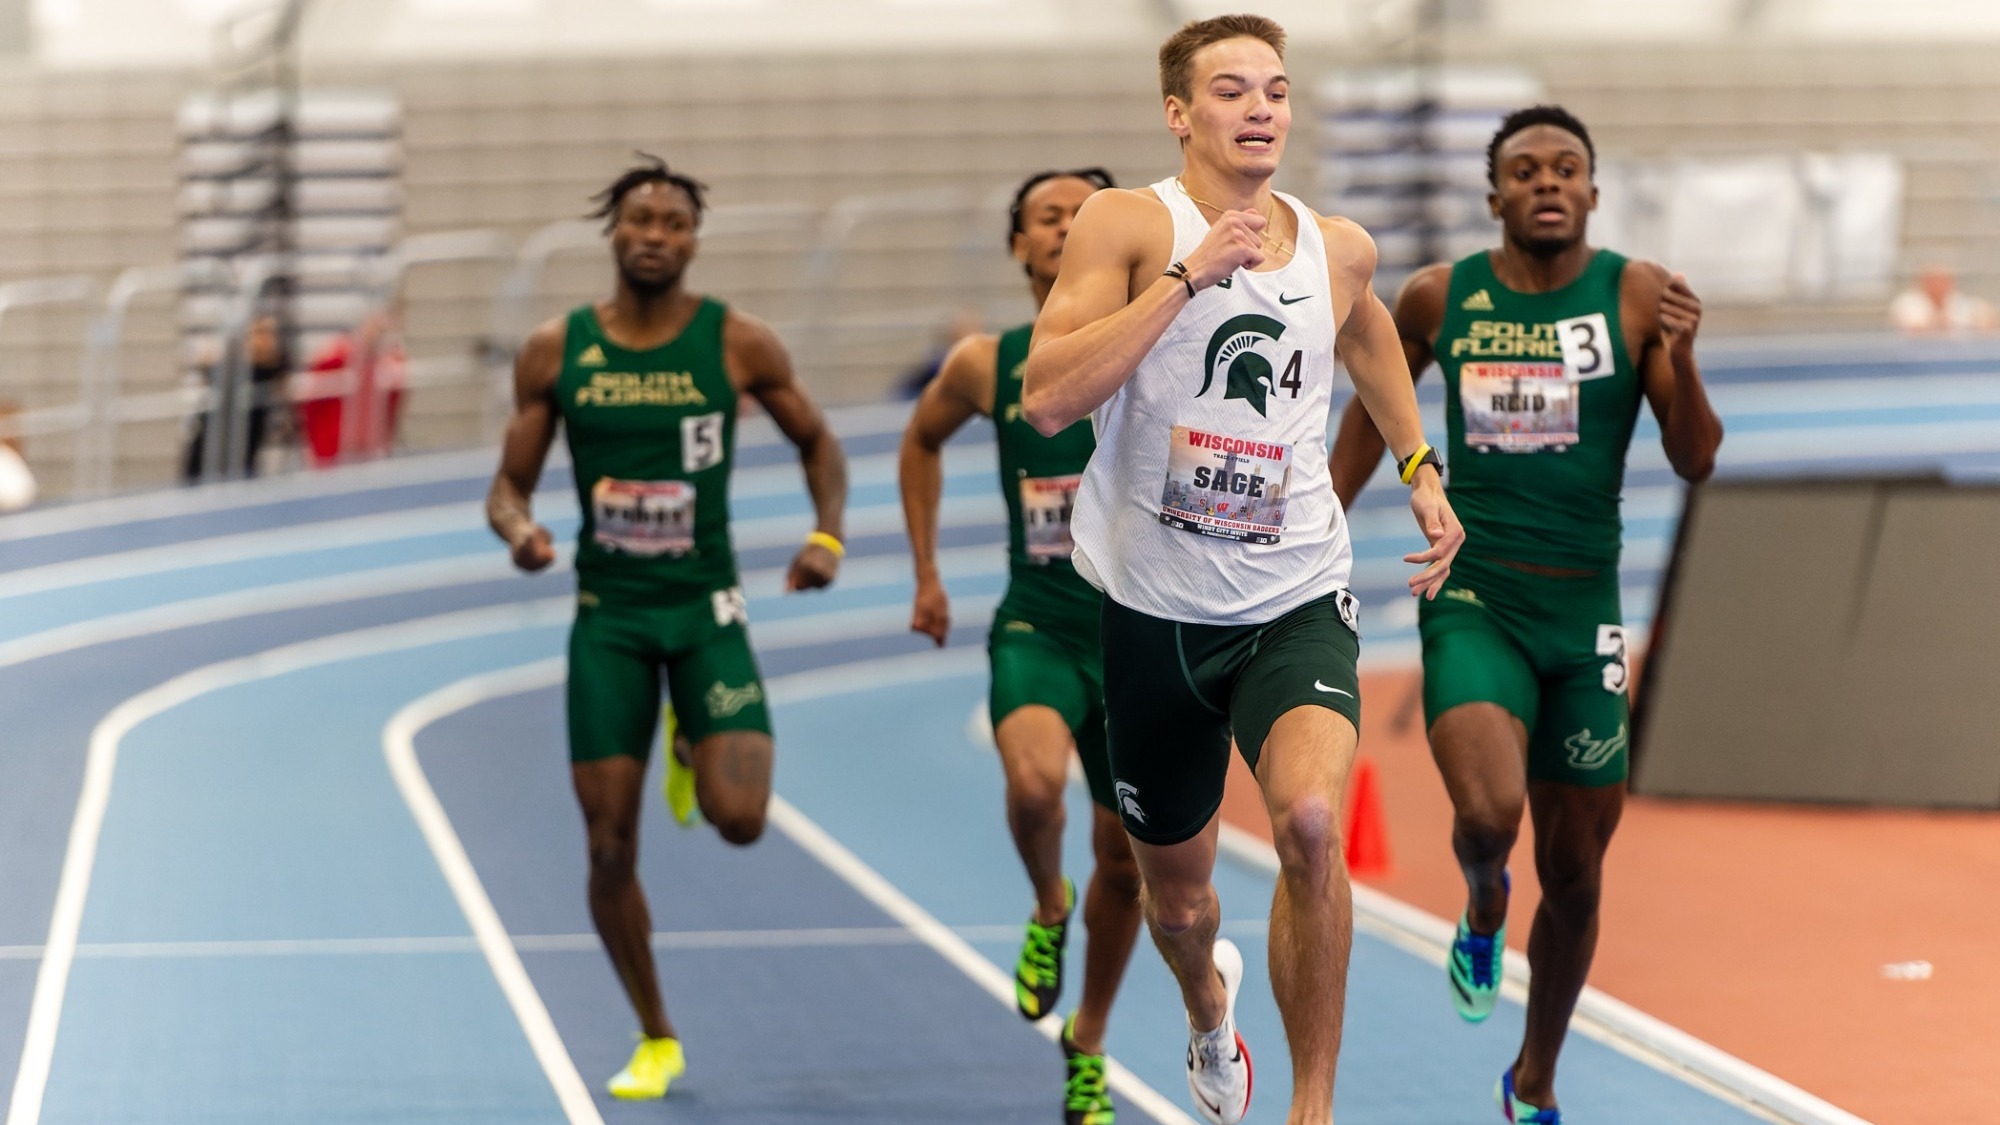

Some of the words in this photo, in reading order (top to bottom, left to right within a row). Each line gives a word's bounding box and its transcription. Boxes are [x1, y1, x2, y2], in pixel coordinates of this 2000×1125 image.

[1470, 320, 1557, 340] SOUT
[1451, 338, 1564, 358] FLORI
[1570, 321, 1601, 375] 3
[1279, 349, 1303, 399] 4
[1477, 364, 1564, 378] WISCONSIN
[1491, 393, 1546, 413] REID
[694, 417, 712, 466] 5
[1189, 430, 1284, 461] WISCONSIN
[1193, 465, 1266, 499] SAGE
[1162, 505, 1202, 522] UNIVERSITY
[1203, 516, 1212, 524] OF
[1214, 519, 1252, 531] WISCONSIN
[1252, 524, 1280, 534] BADGERS
